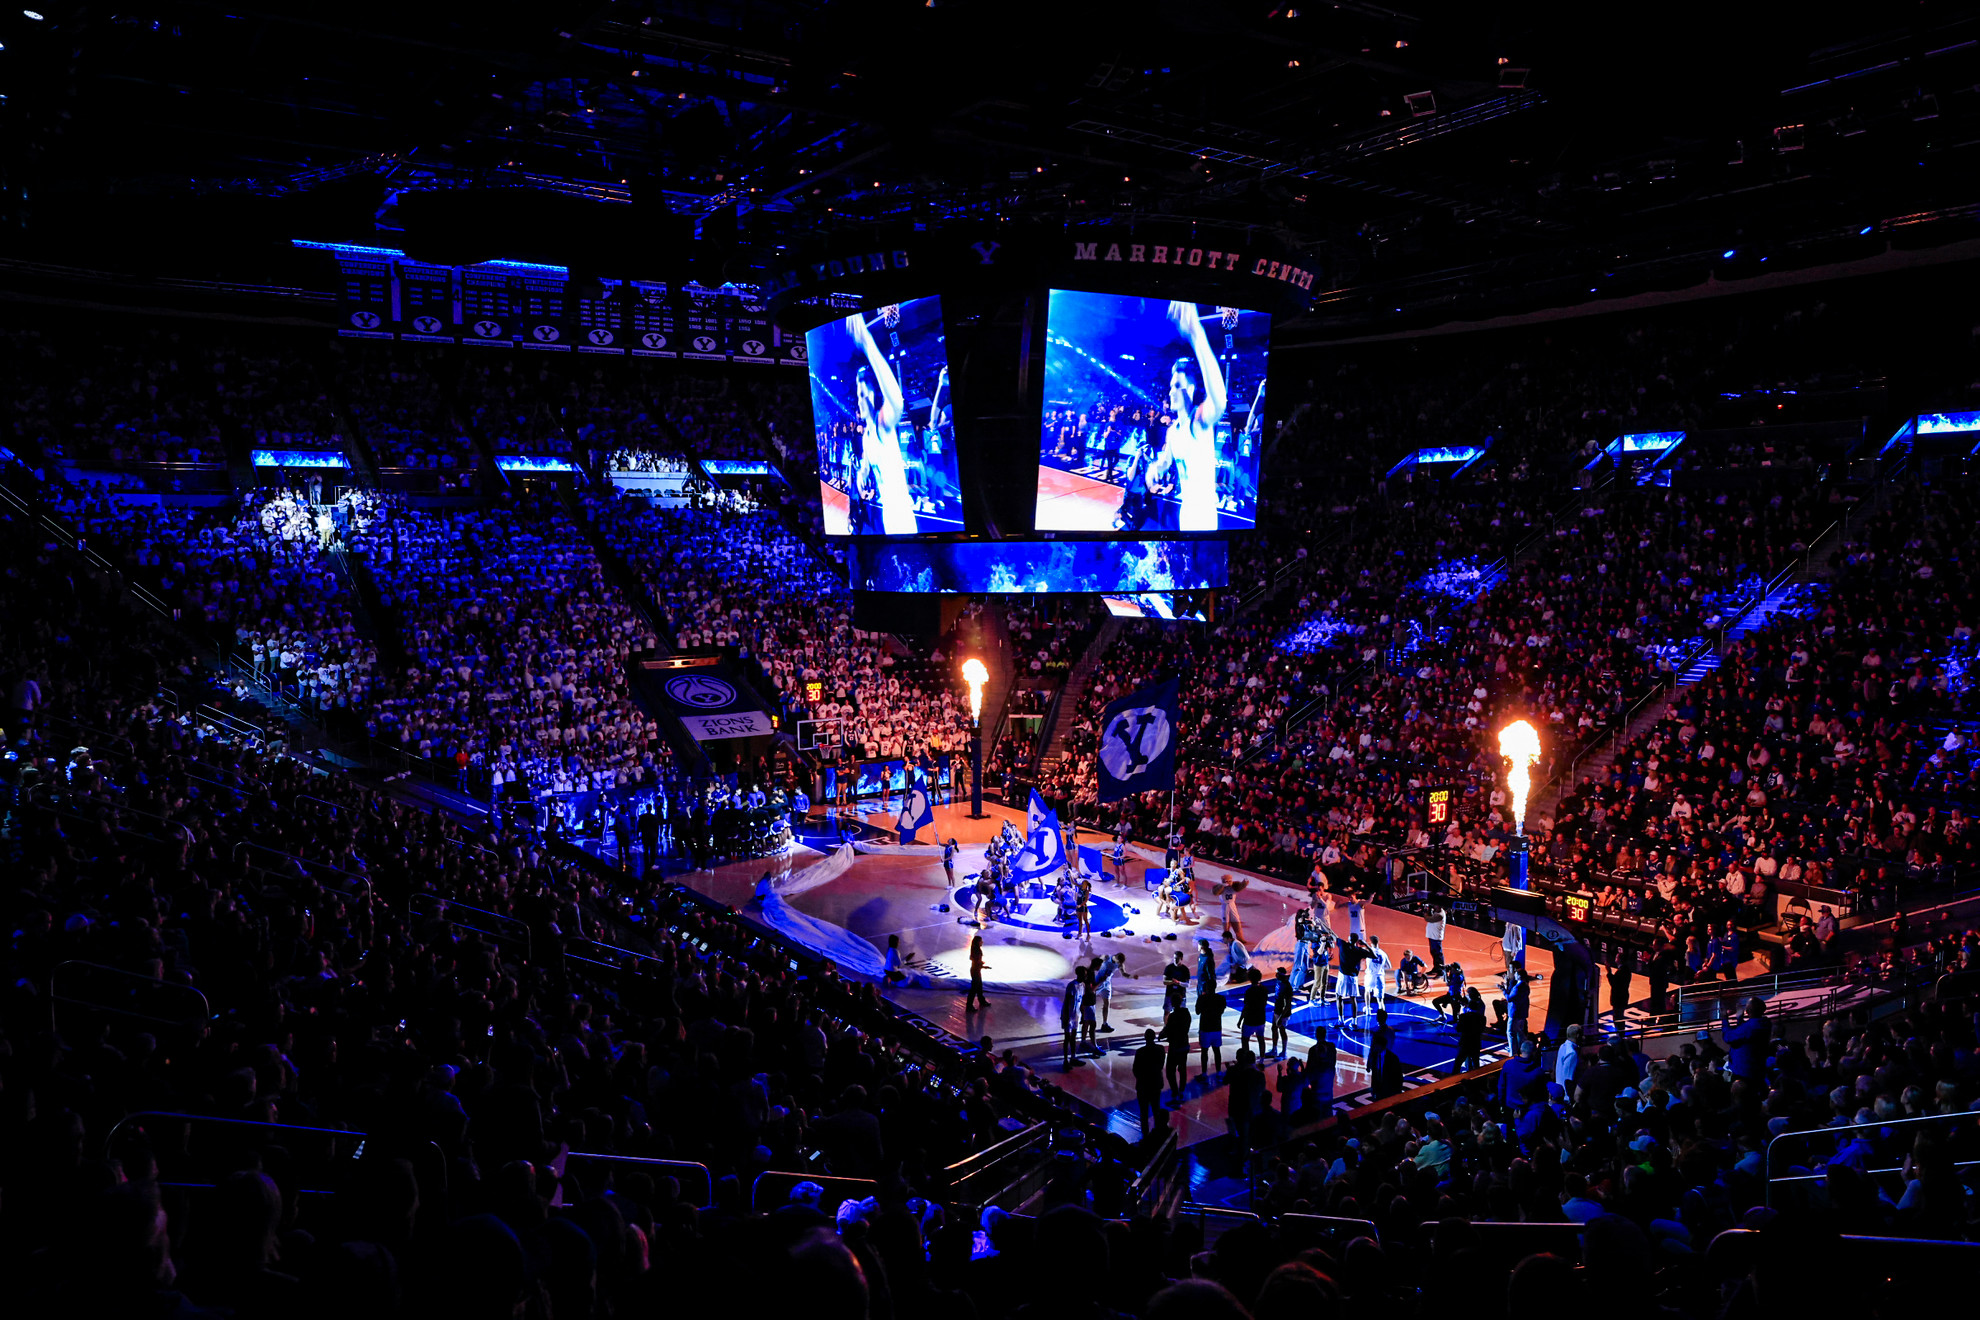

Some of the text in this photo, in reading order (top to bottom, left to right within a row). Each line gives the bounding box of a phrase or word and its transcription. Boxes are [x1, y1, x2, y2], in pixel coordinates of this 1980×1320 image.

[1073, 241, 1240, 271] MARRIOTT
[810, 249, 909, 282] YOUNG
[806, 682, 822, 690] 20:00
[808, 690, 820, 702] 30
[698, 716, 754, 728] ZIONS
[706, 724, 760, 736] BANK
[1111, 712, 1156, 774] Y
[1429, 790, 1449, 804] 20:00
[1430, 803, 1446, 822] 30
[1566, 895, 1589, 909] 20:00
[1571, 906, 1584, 920] 30
